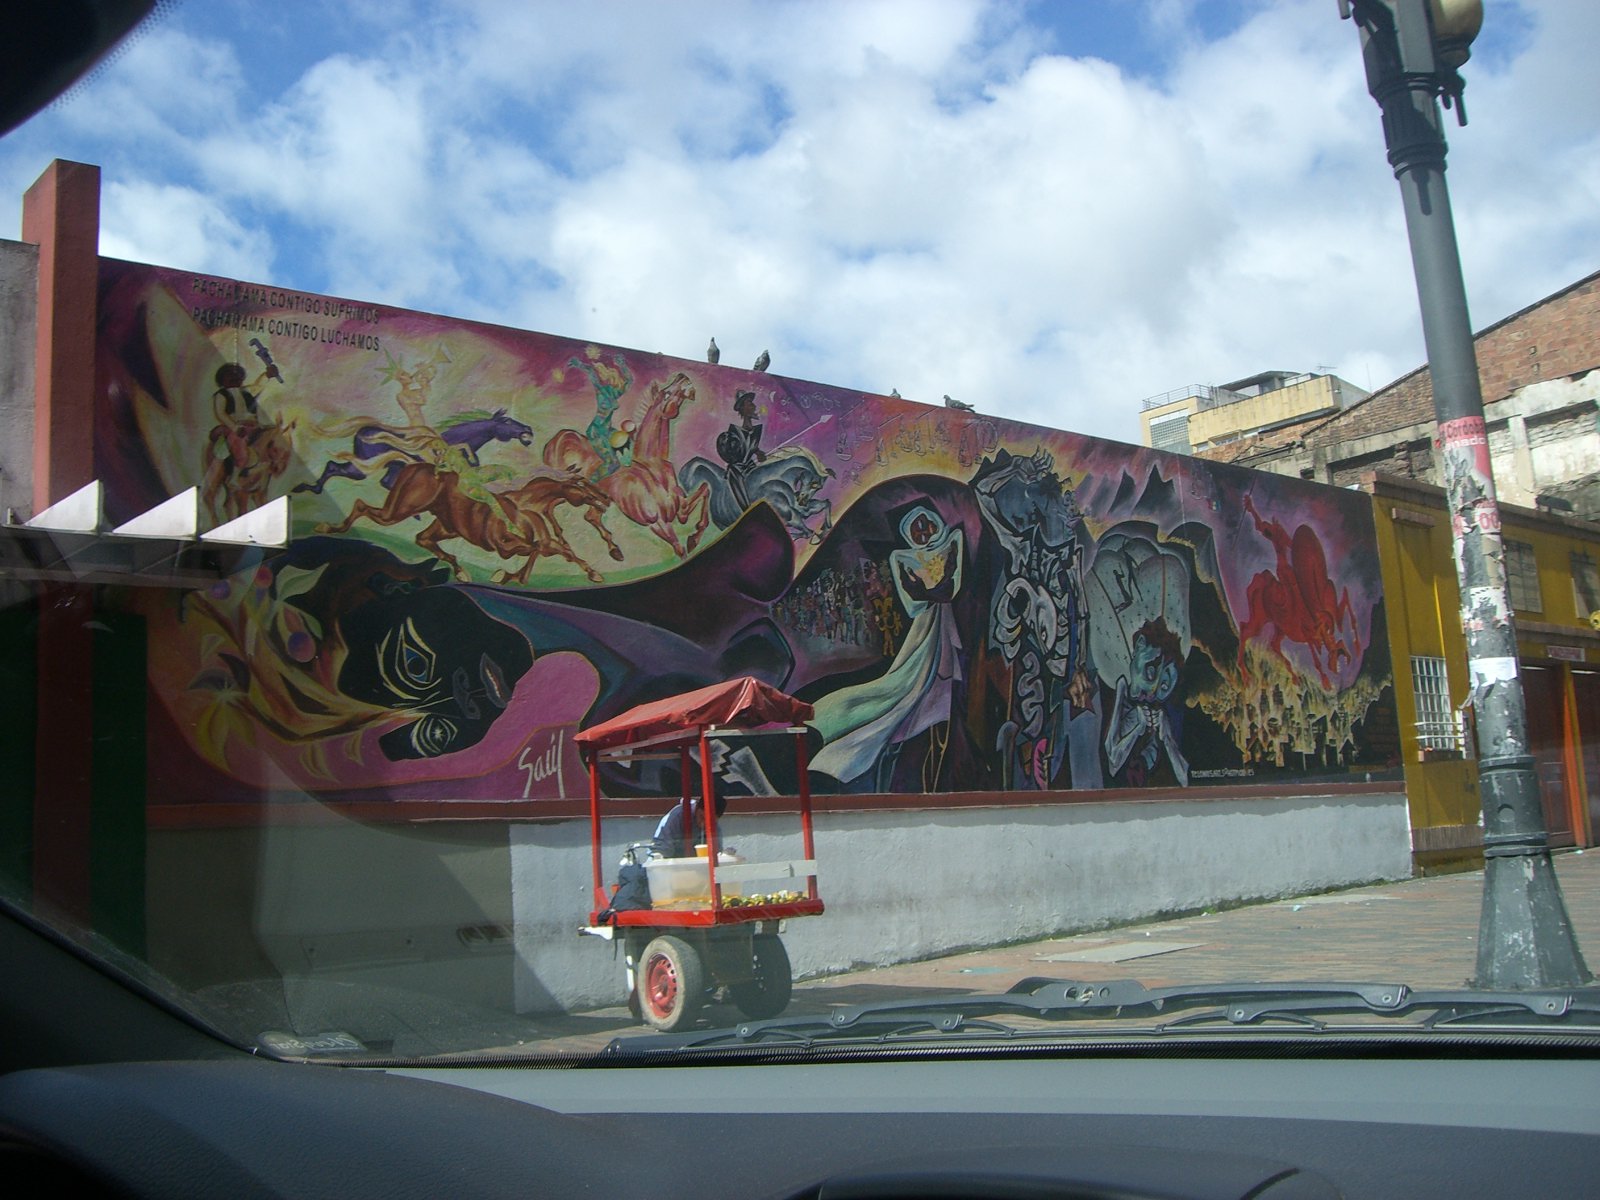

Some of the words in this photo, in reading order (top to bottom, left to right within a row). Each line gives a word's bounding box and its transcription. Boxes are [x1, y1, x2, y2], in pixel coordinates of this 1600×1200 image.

[270, 291, 320, 314] CONTIGO
[323, 300, 379, 324] SUFRIMOS
[192, 306, 265, 334] PACHAMAMA
[268, 319, 318, 341] CONTIGO
[321, 328, 380, 351] LUCHAMOS
